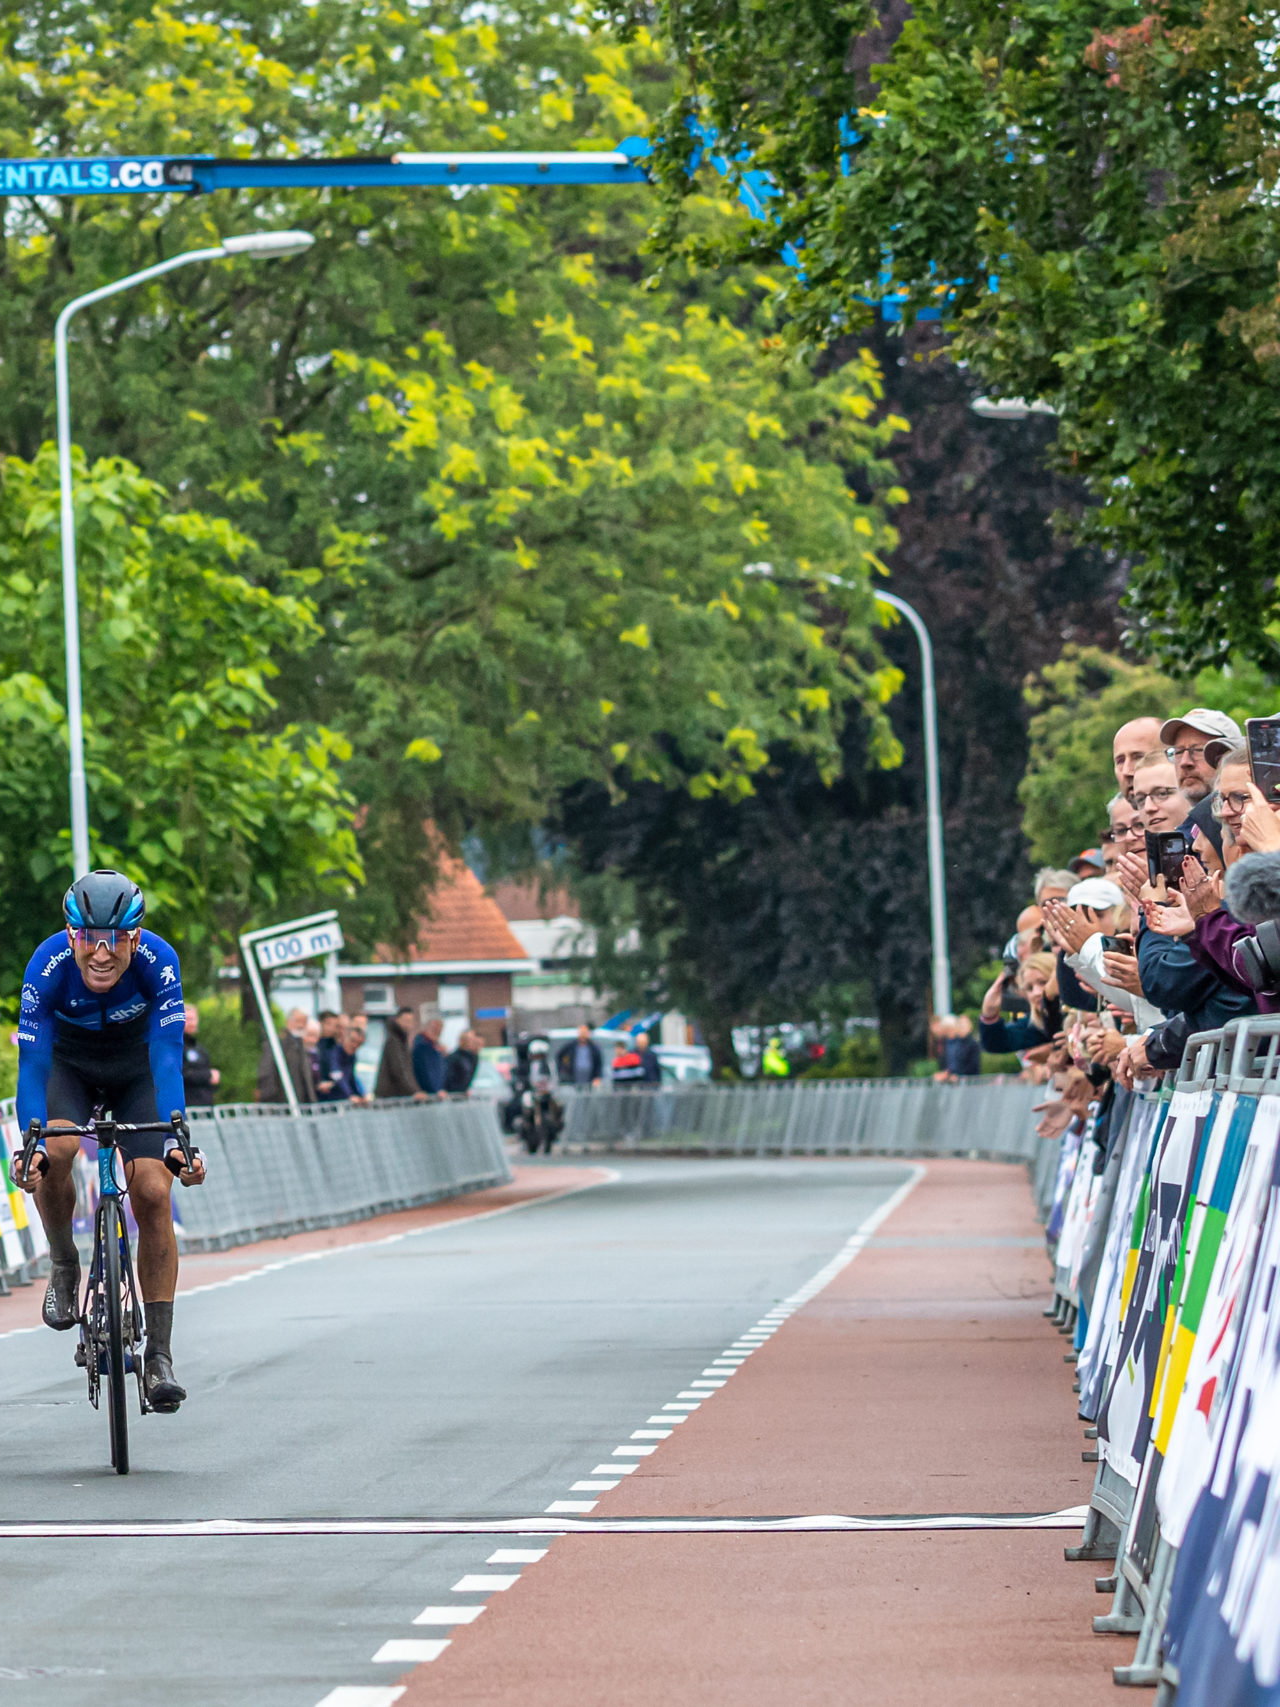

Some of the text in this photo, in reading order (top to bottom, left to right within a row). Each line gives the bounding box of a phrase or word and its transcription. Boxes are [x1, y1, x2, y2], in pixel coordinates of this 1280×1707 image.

[136, 943, 157, 964] ahoo
[263, 931, 332, 963] 100 m
[41, 947, 71, 977] wahoo
[109, 1002, 147, 1022] dhb
